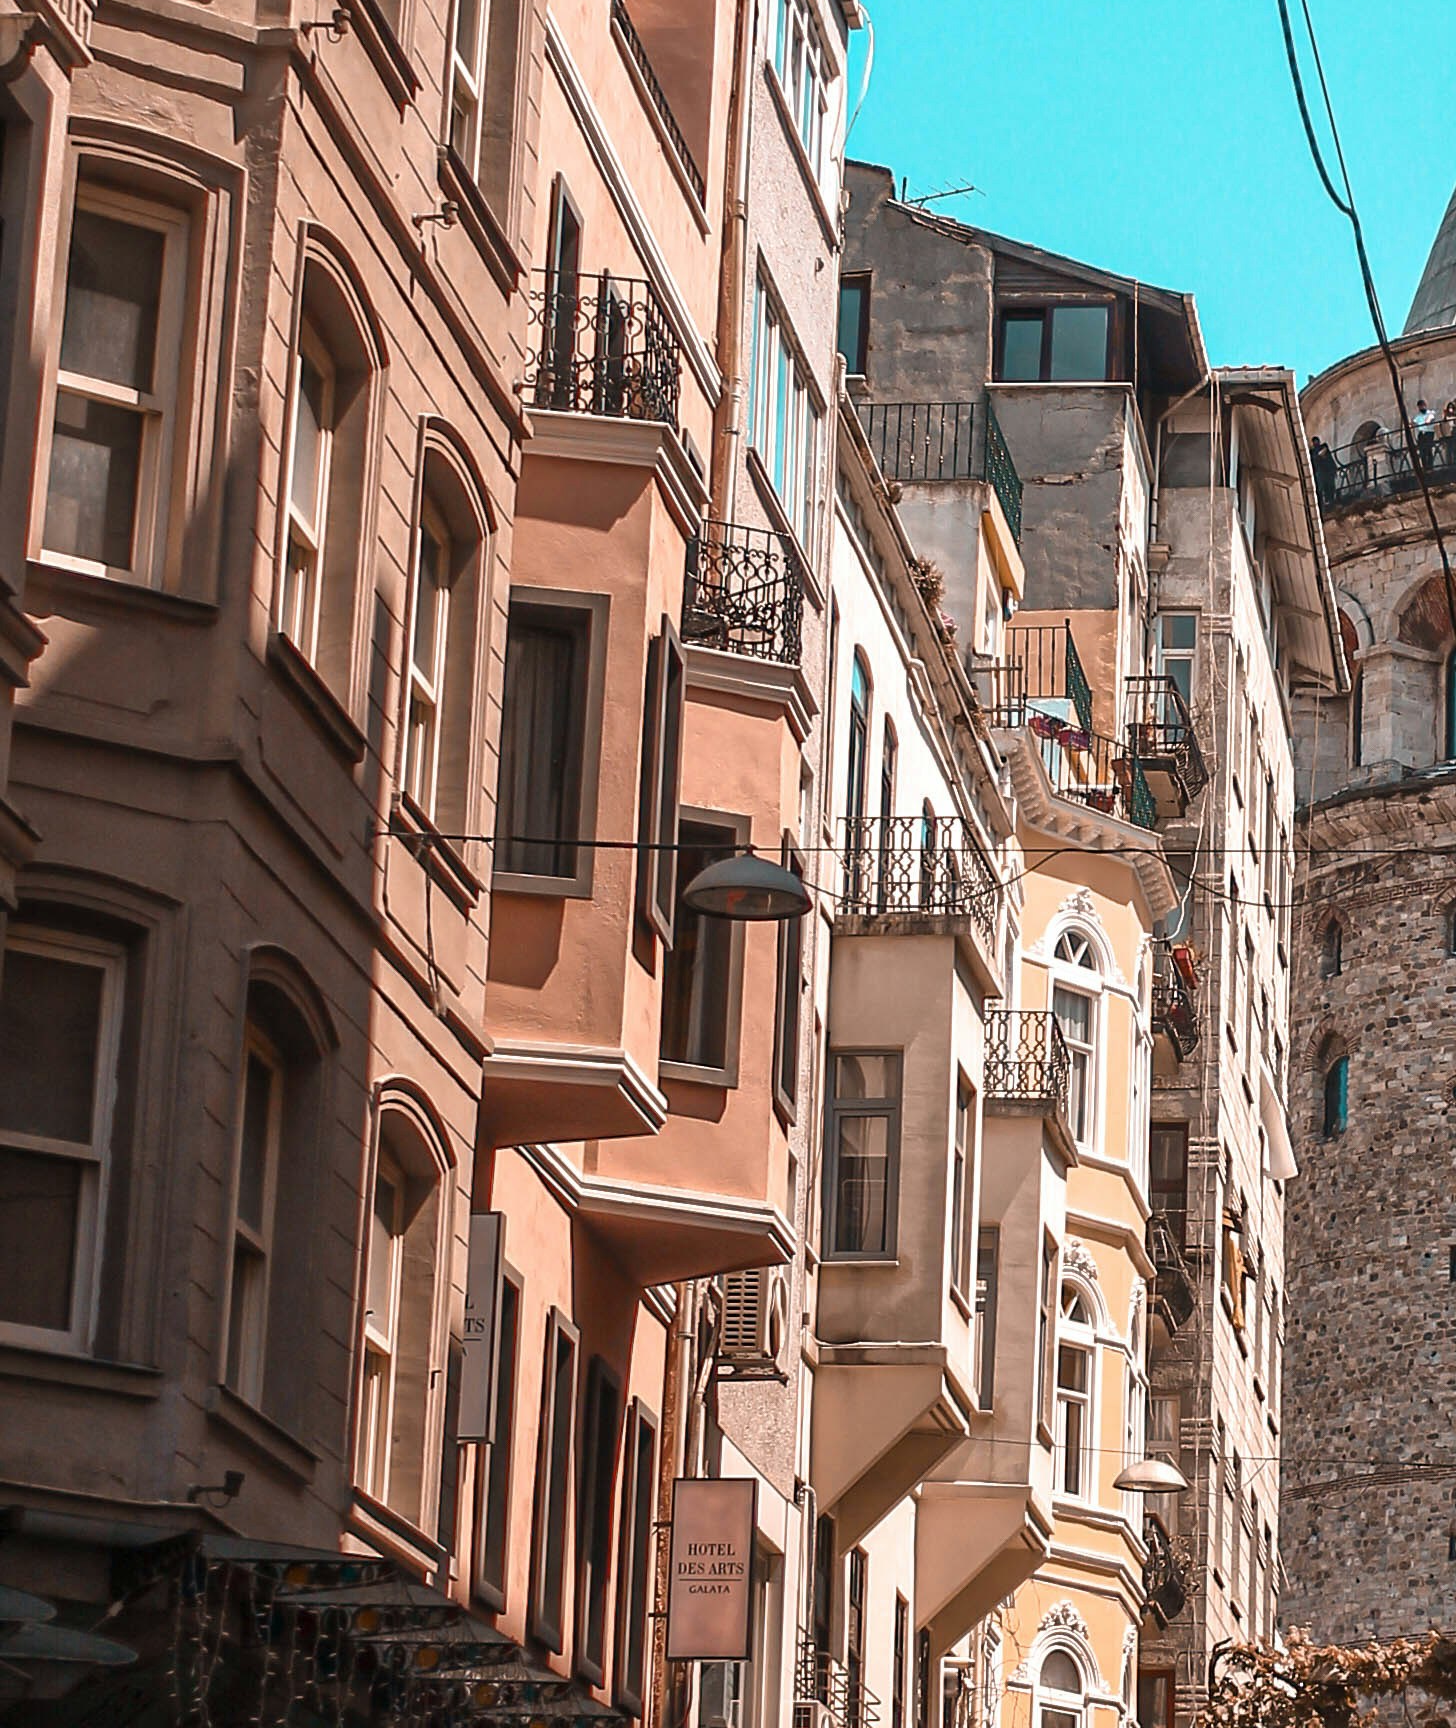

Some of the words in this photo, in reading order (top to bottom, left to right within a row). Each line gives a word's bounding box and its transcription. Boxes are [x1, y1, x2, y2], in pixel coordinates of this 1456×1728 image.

[688, 1543, 736, 1556] HOTEL
[678, 1562, 705, 1575] DES
[708, 1562, 744, 1575] ARTS
[689, 1584, 730, 1594] GALATA
